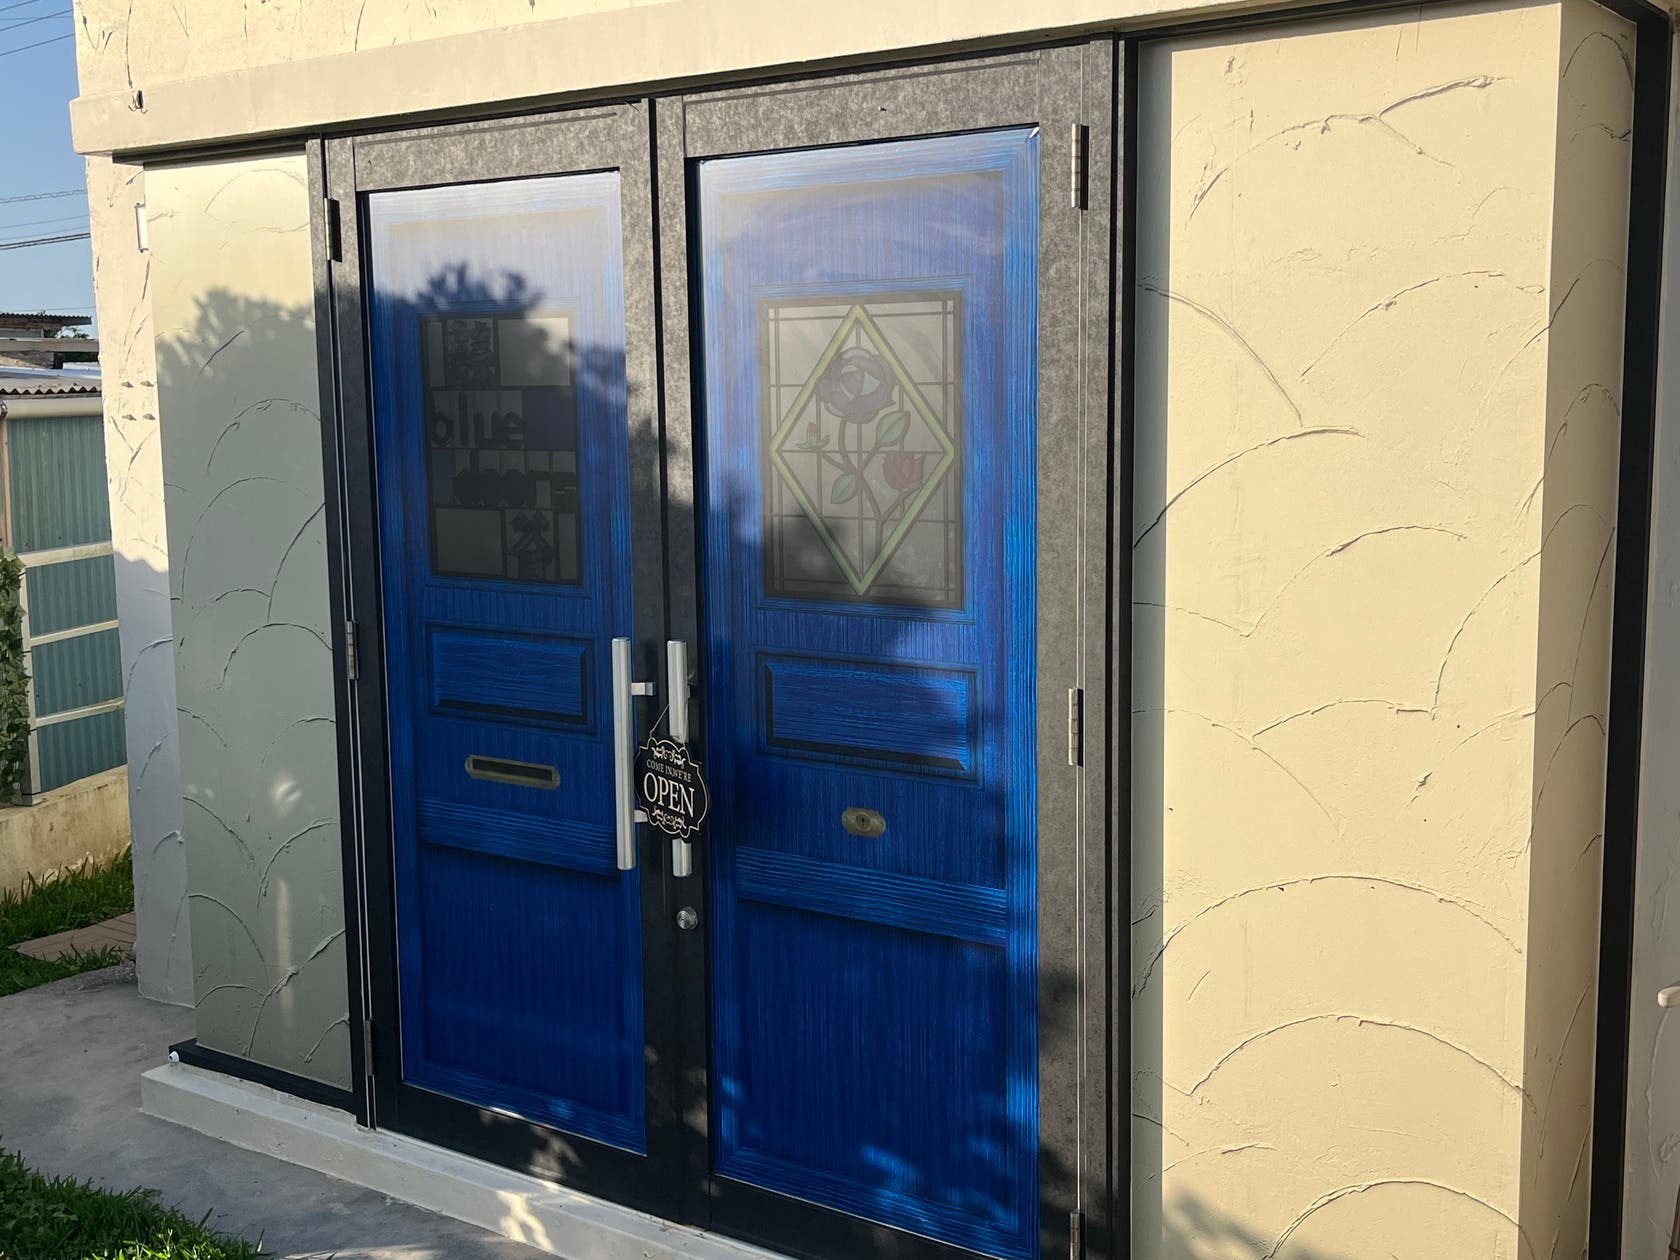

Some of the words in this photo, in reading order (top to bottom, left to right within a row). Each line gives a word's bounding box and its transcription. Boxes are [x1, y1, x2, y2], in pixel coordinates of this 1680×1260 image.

[429, 391, 525, 448] blue
[646, 759, 665, 773] COME
[643, 772, 695, 818] OPEN
